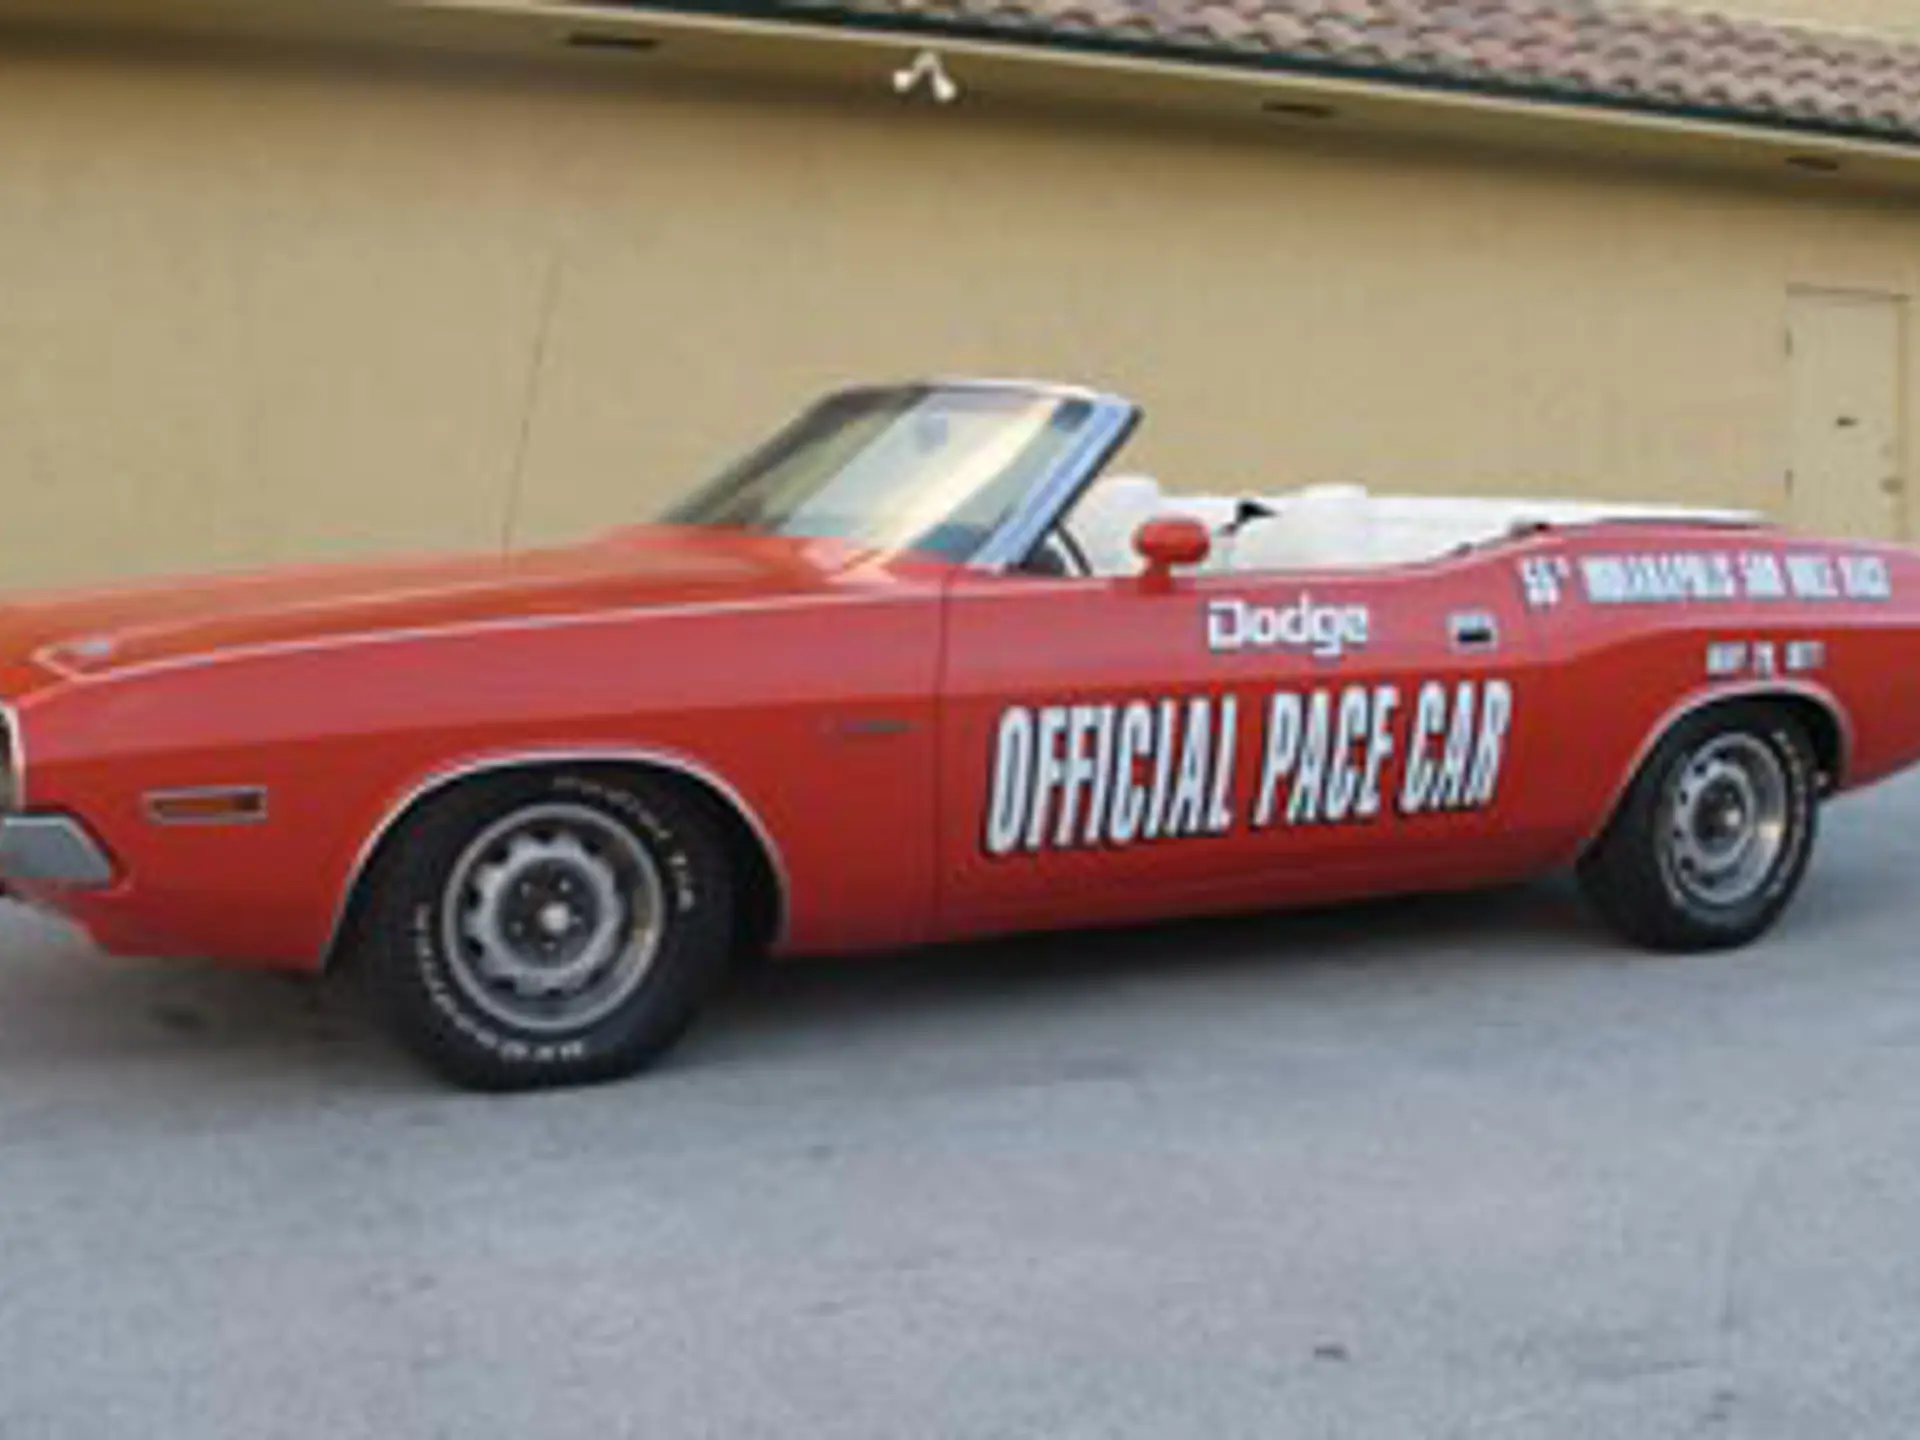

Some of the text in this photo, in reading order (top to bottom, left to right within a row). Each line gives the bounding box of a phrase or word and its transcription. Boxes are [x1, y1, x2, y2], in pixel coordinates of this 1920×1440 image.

[1207, 594, 1369, 657] Dodge
[983, 678, 1513, 855] OFFICIAL PACE CAR
